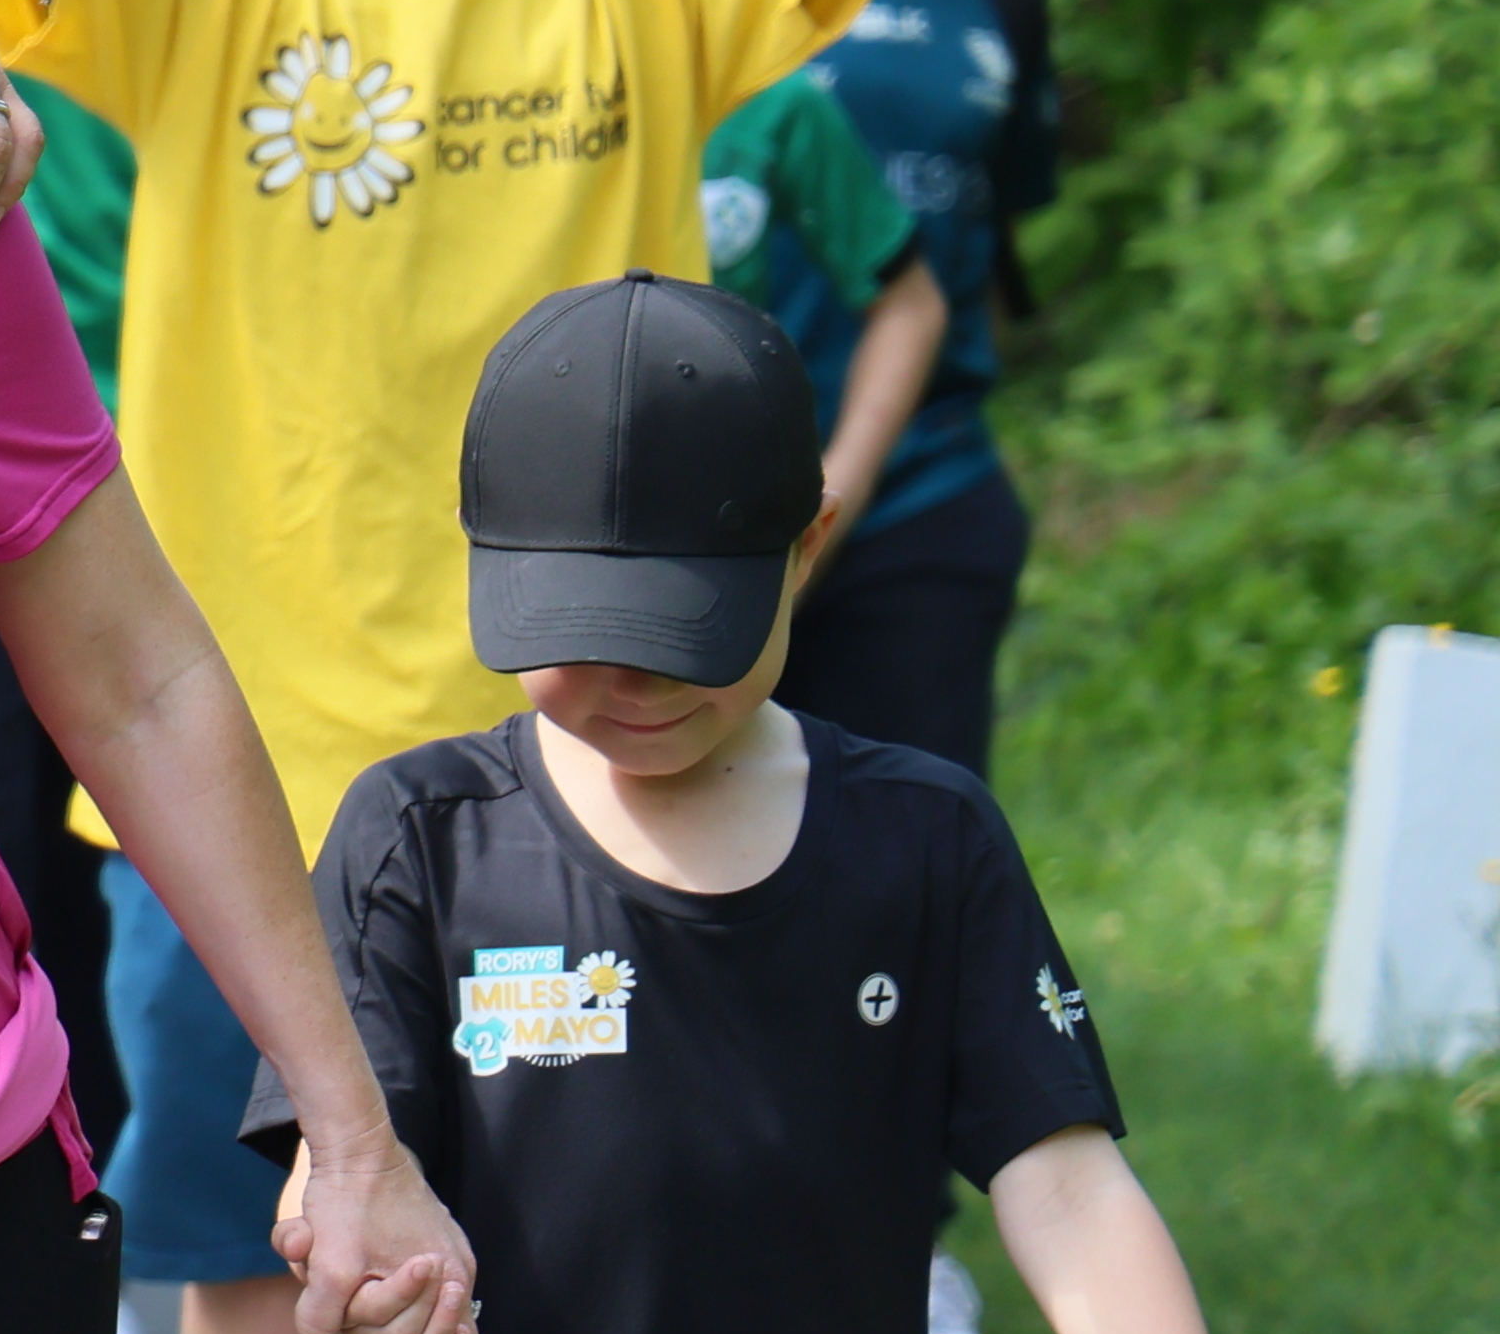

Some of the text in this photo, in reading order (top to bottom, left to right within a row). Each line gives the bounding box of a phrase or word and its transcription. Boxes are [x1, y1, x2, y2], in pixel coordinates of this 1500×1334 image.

[477, 949, 559, 974] RORY'S
[471, 978, 570, 1012] MILES
[475, 1014, 620, 1061] 2 MAYO
